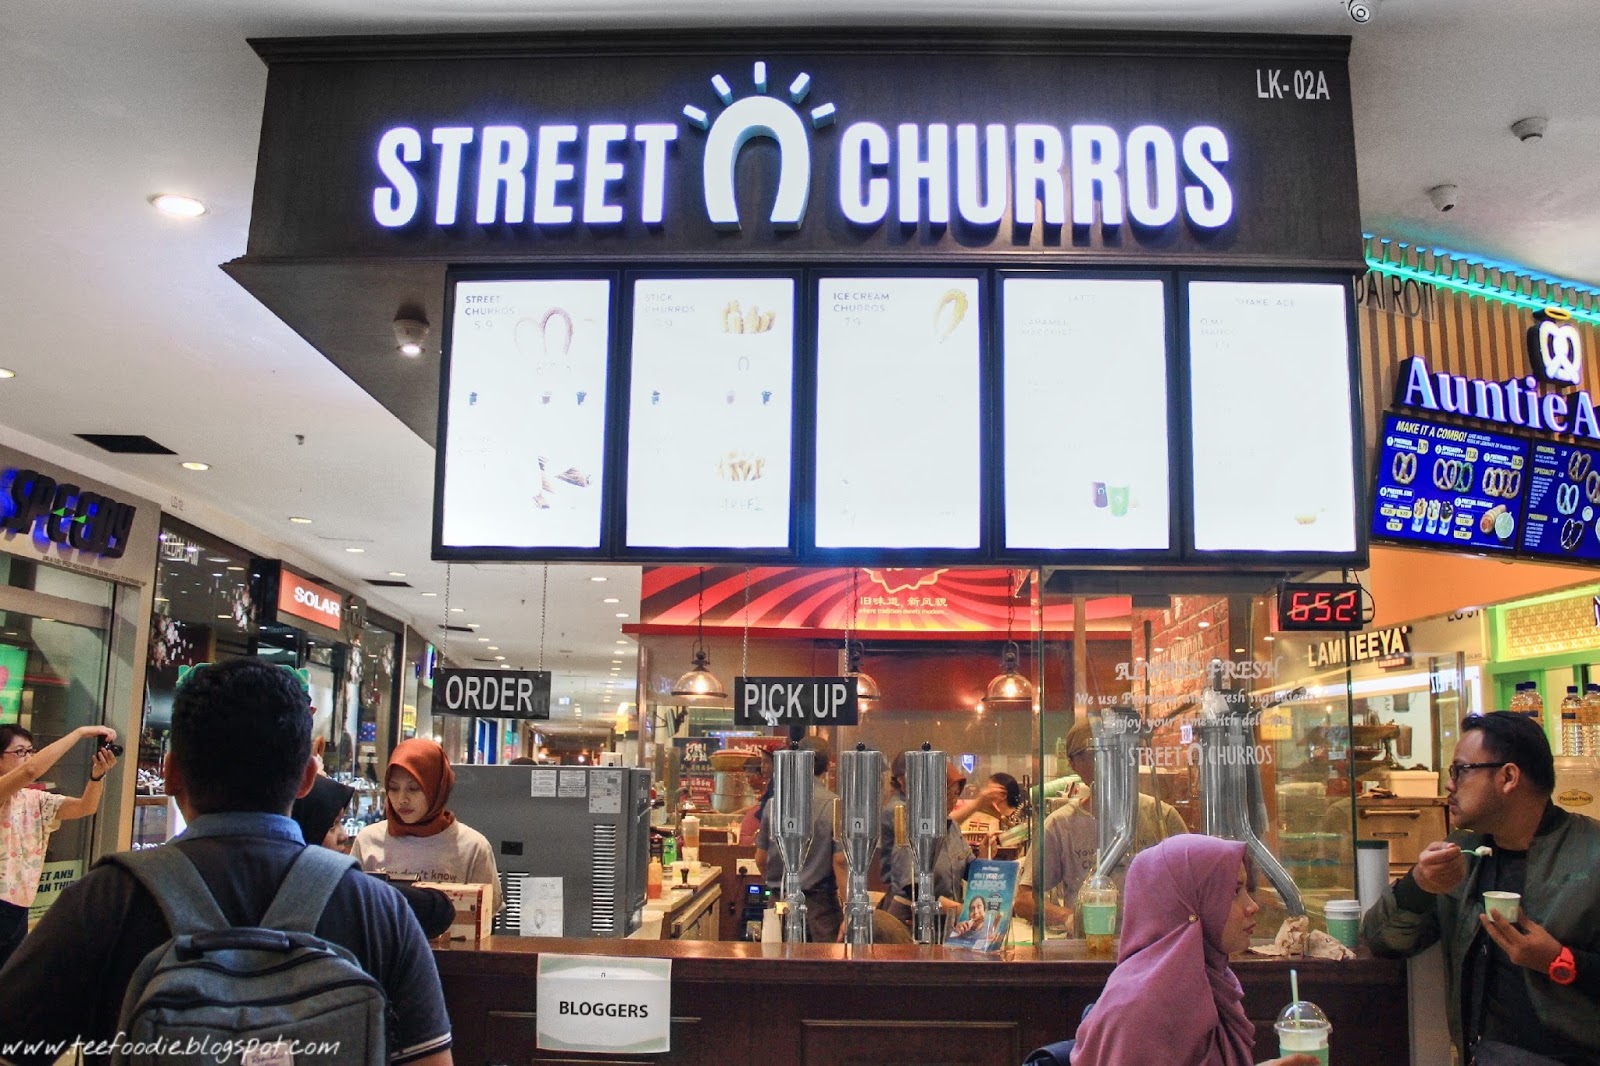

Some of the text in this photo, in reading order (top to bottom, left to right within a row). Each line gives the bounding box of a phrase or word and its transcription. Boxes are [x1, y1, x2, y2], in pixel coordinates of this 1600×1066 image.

[373, 120, 1234, 230] STREET CHURROS
[465, 295, 501, 304] STREET
[833, 292, 890, 301] ICE CREAM
[464, 307, 515, 316] CHURROS
[832, 304, 886, 313] CHURROS
[1402, 355, 1569, 434] Auntie
[1396, 420, 1421, 435] MAKE
[1419, 425, 1430, 436] IT
[1428, 427, 1436, 438] A
[1436, 427, 1469, 443] COMBO!
[293, 586, 341, 618] SOLAR
[1115, 656, 1284, 682] ALWAYS FRESH
[445, 675, 534, 712] ORDER
[743, 683, 848, 719] PICK UP
[1075, 692, 1094, 705] We
[1098, 694, 1118, 705] use
[1144, 718, 1176, 734] your
[1211, 711, 1239, 727] with
[1128, 745, 1273, 767] STREET CHURROS
[53, 868, 75, 881] ANY
[430, 870, 458, 881] know
[969, 880, 1007, 891] CHURROS
[558, 1001, 649, 1019] BLOGGERS
